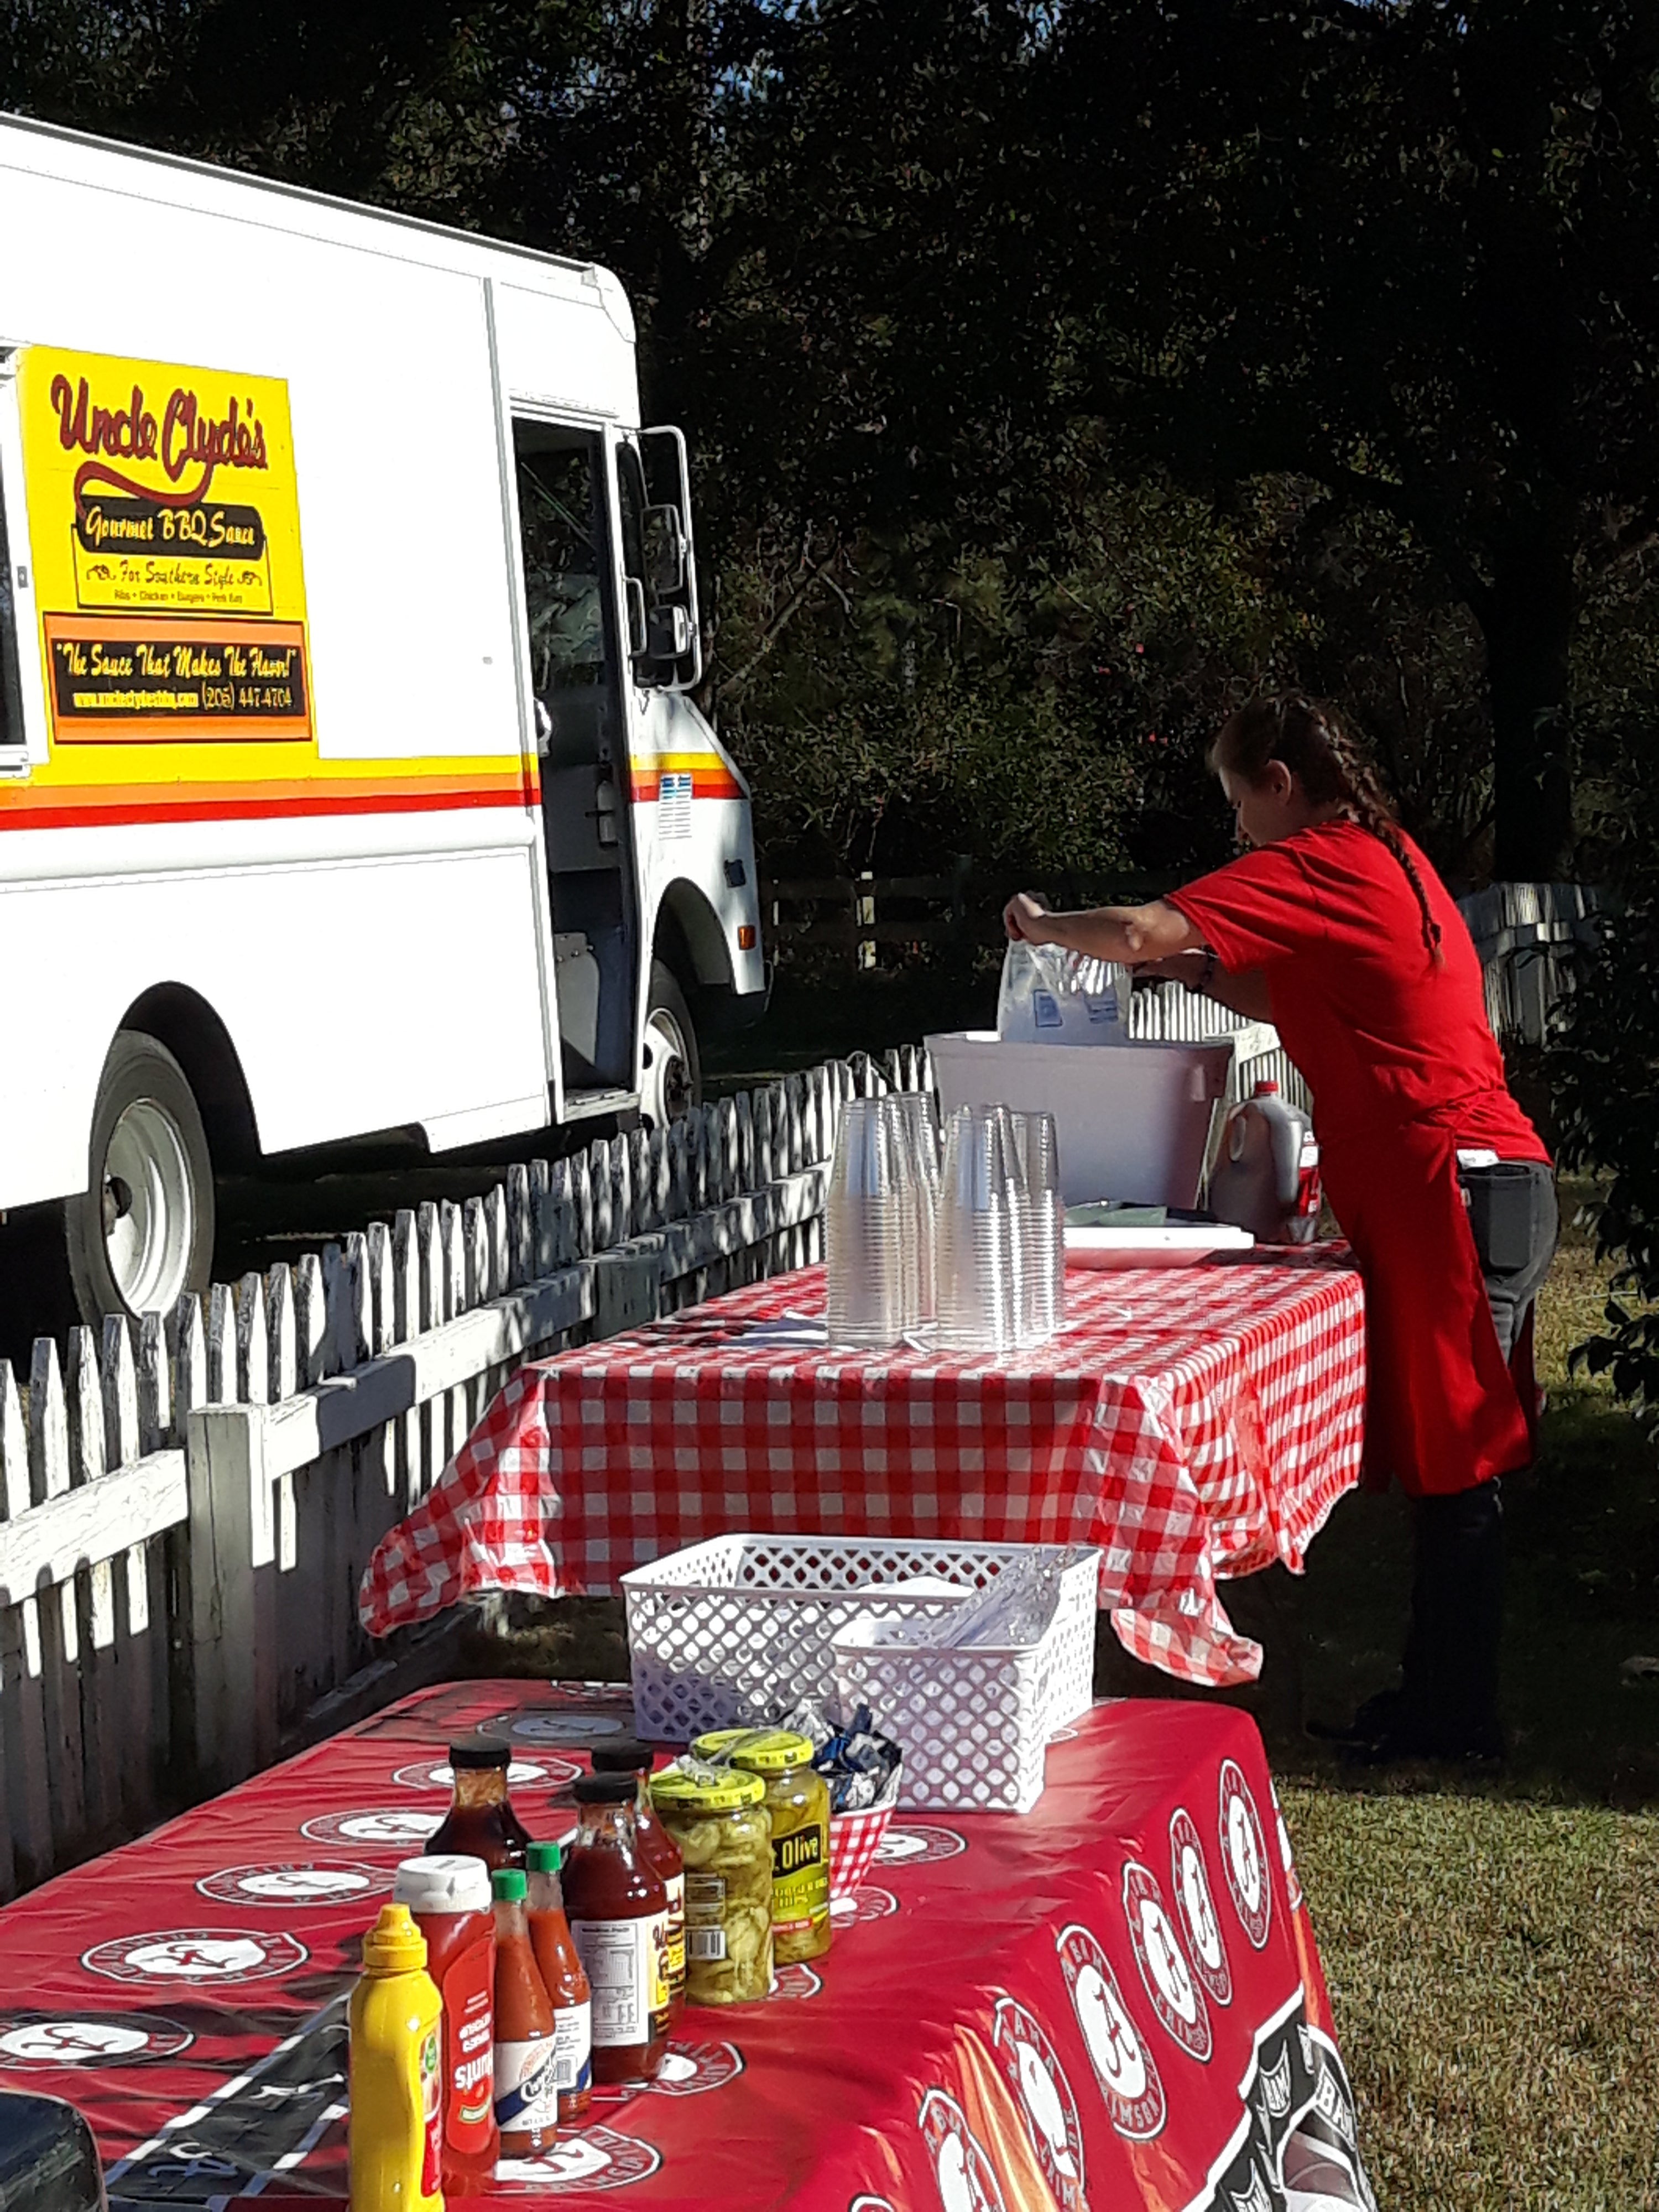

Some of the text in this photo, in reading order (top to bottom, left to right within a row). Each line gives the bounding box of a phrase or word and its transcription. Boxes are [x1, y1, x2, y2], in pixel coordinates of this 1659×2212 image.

[51, 374, 269, 482] Uncle Clyde's
[86, 505, 255, 547] Gourmet BBQ Sauce
[119, 559, 234, 590] For Southern Style
[91, 643, 133, 676] Sauce
[135, 644, 170, 678] That
[173, 645, 221, 679] Makes
[224, 645, 247, 677] The
[202, 681, 235, 711] (205)
[782, 1836, 819, 1869] Olive
